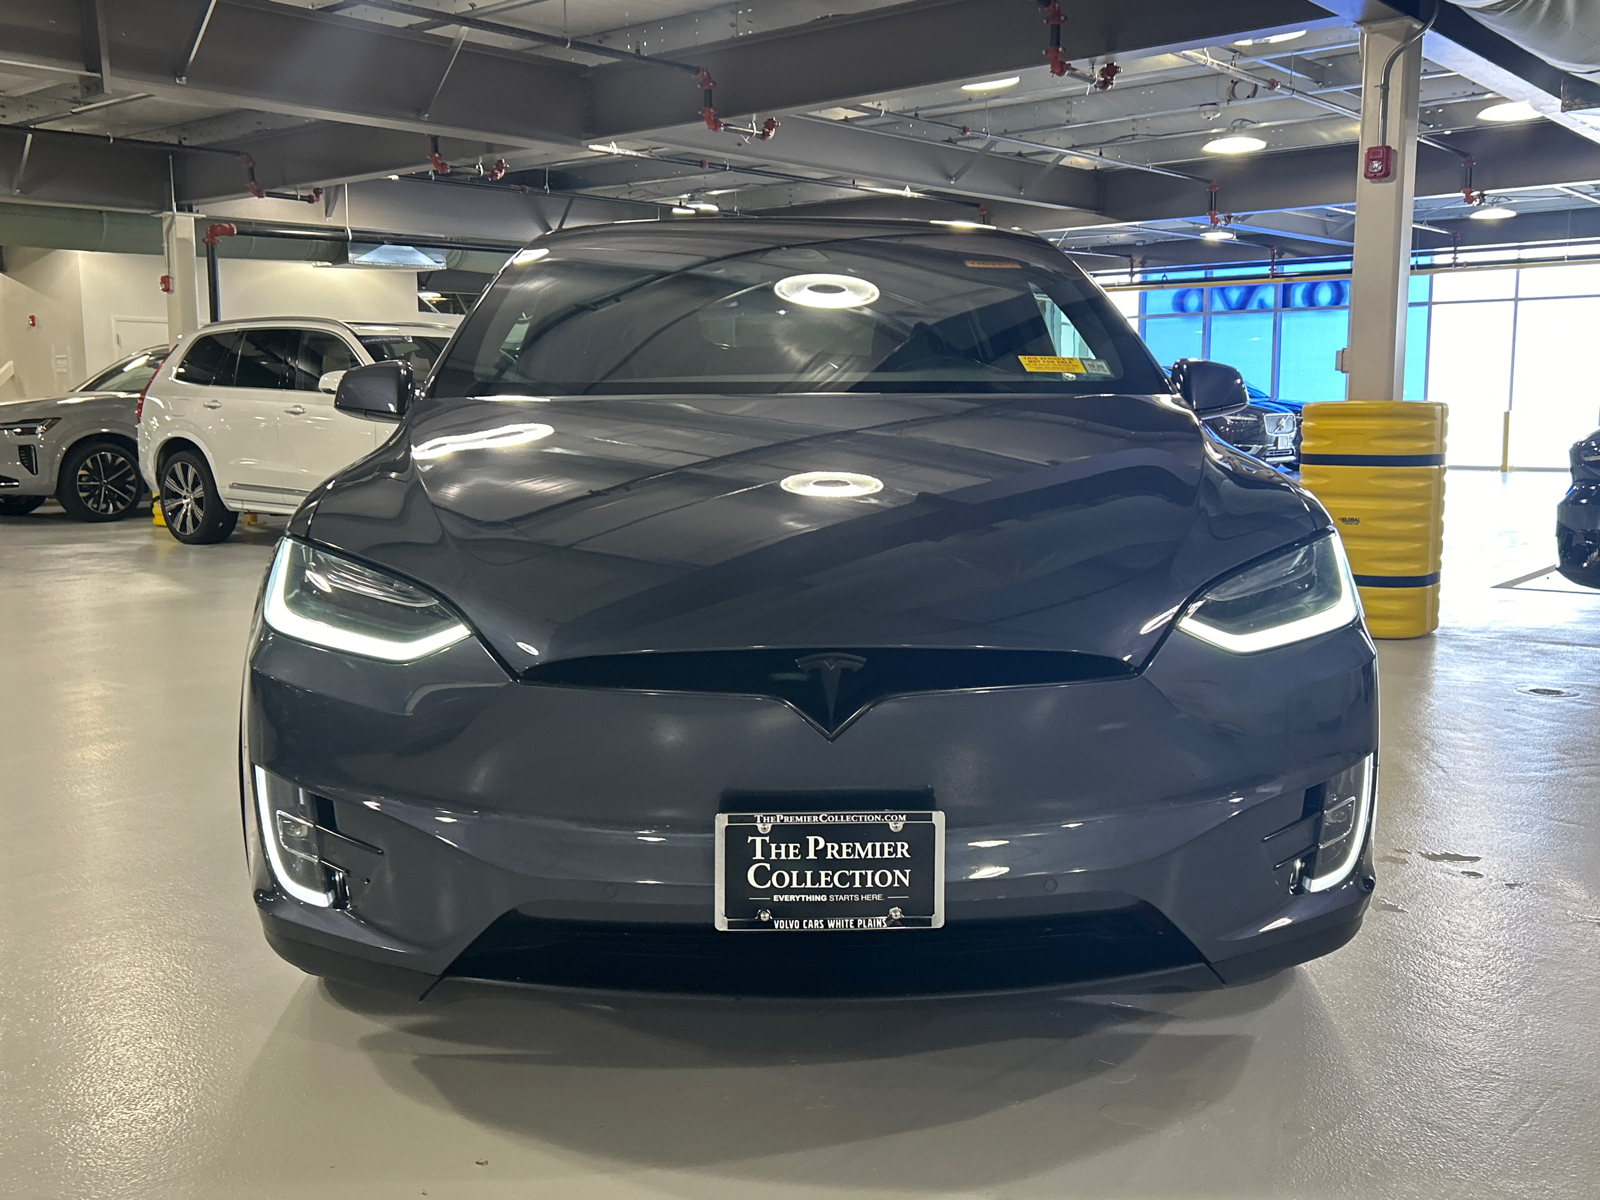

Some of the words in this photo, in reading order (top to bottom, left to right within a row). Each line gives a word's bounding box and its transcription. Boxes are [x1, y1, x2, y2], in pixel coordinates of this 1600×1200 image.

[747, 836, 801, 861] THE
[806, 835, 911, 860] PREMIER
[747, 862, 911, 889] COLLECTION
[773, 894, 827, 902] EVERYTHING
[829, 894, 860, 902] STARTS
[773, 919, 800, 930] VOLVO
[802, 919, 825, 929] CARS
[827, 918, 855, 929] WHITE
[857, 918, 888, 928] PLAINS
